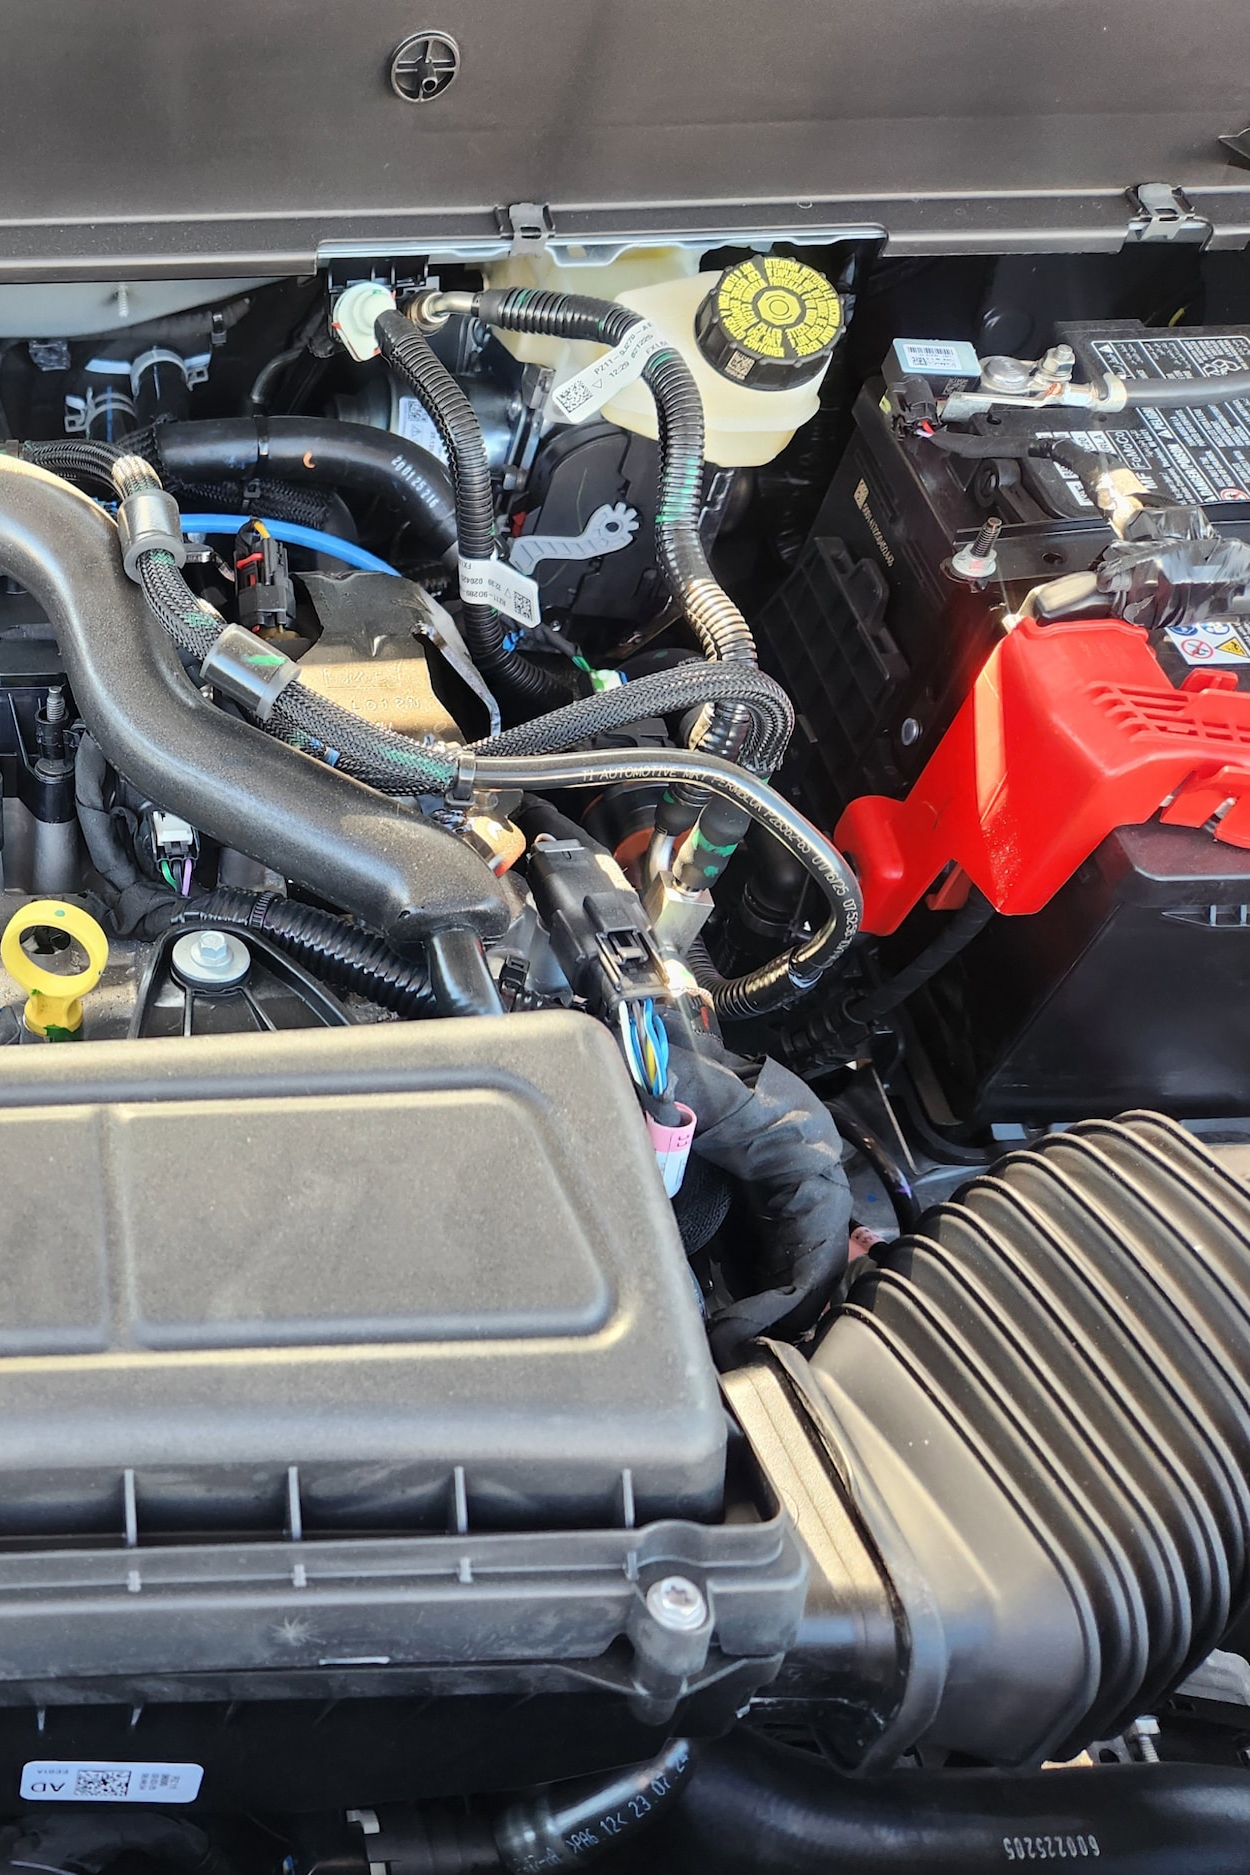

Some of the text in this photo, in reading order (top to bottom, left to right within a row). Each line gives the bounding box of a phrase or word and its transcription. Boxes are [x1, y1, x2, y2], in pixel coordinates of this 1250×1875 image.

[1115, 431, 1143, 468] FoMoCo
[582, 769, 594, 782] TI
[599, 766, 680, 780] AUTOMOTIVE
[30, 1782, 66, 1793] AD
[1002, 1834, 1101, 1860] 600225205
